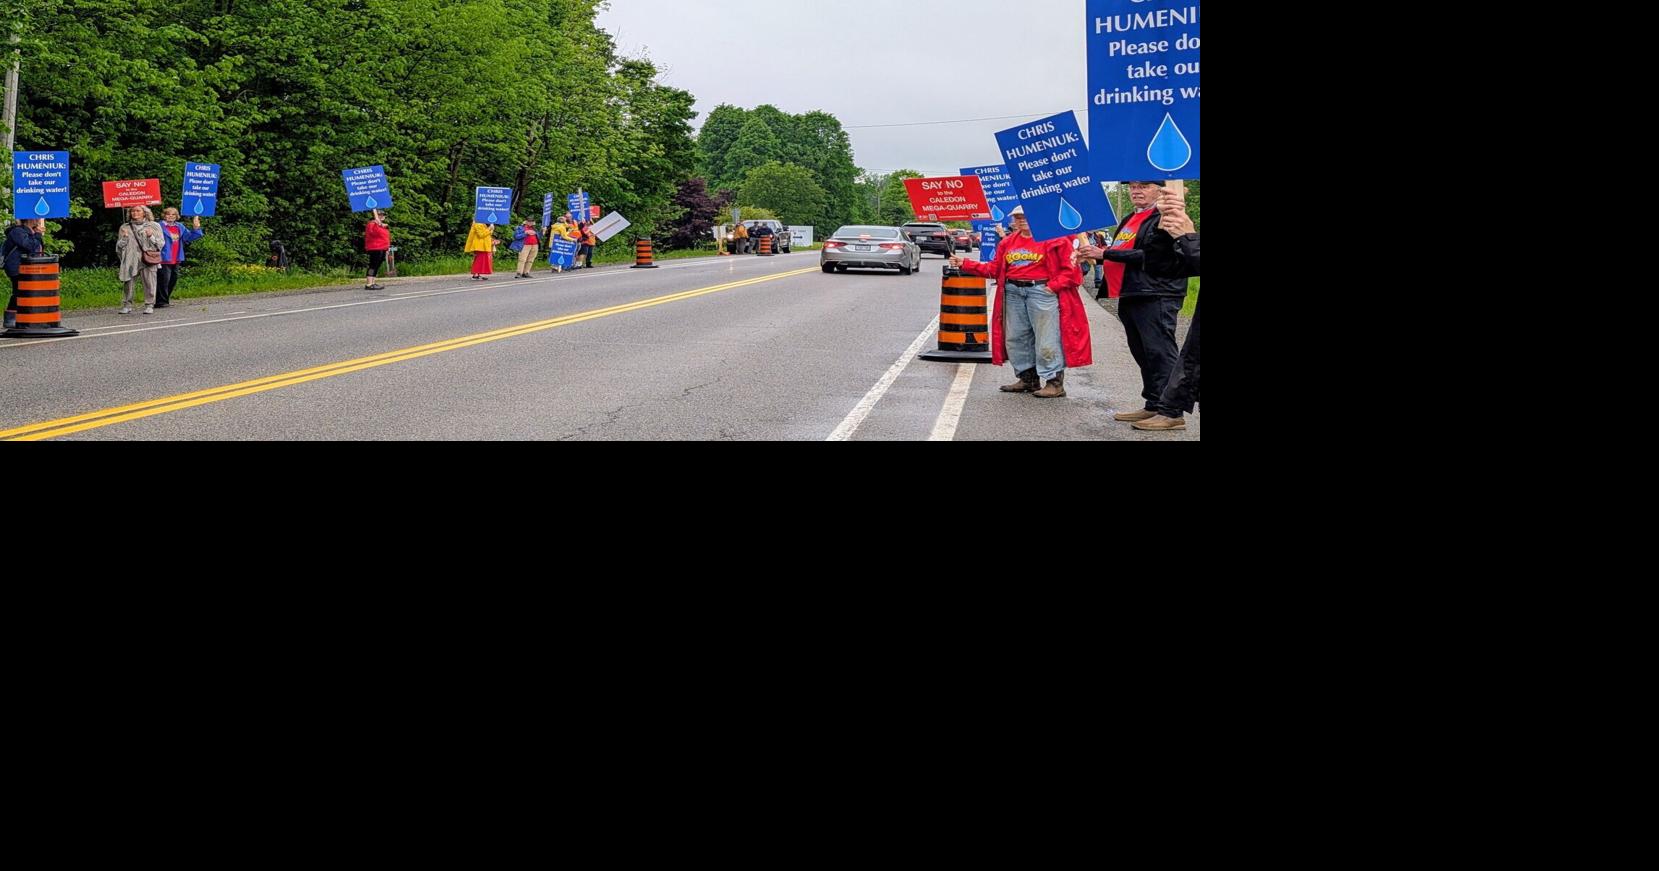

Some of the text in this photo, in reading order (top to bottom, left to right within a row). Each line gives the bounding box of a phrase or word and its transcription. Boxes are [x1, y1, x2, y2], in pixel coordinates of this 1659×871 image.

[1095, 6, 1200, 34] HUMENI
[1109, 39, 1168, 56] Please
[1127, 61, 1200, 79] take ou
[1094, 85, 1174, 105] drinking
[1018, 121, 1054, 140] CHRIS
[1006, 132, 1079, 160] HUMENIUK:
[1018, 148, 1078, 172] Please don't
[1032, 165, 1072, 182] take our
[921, 180, 964, 190] SAY NO
[1021, 183, 1062, 200] drinking
